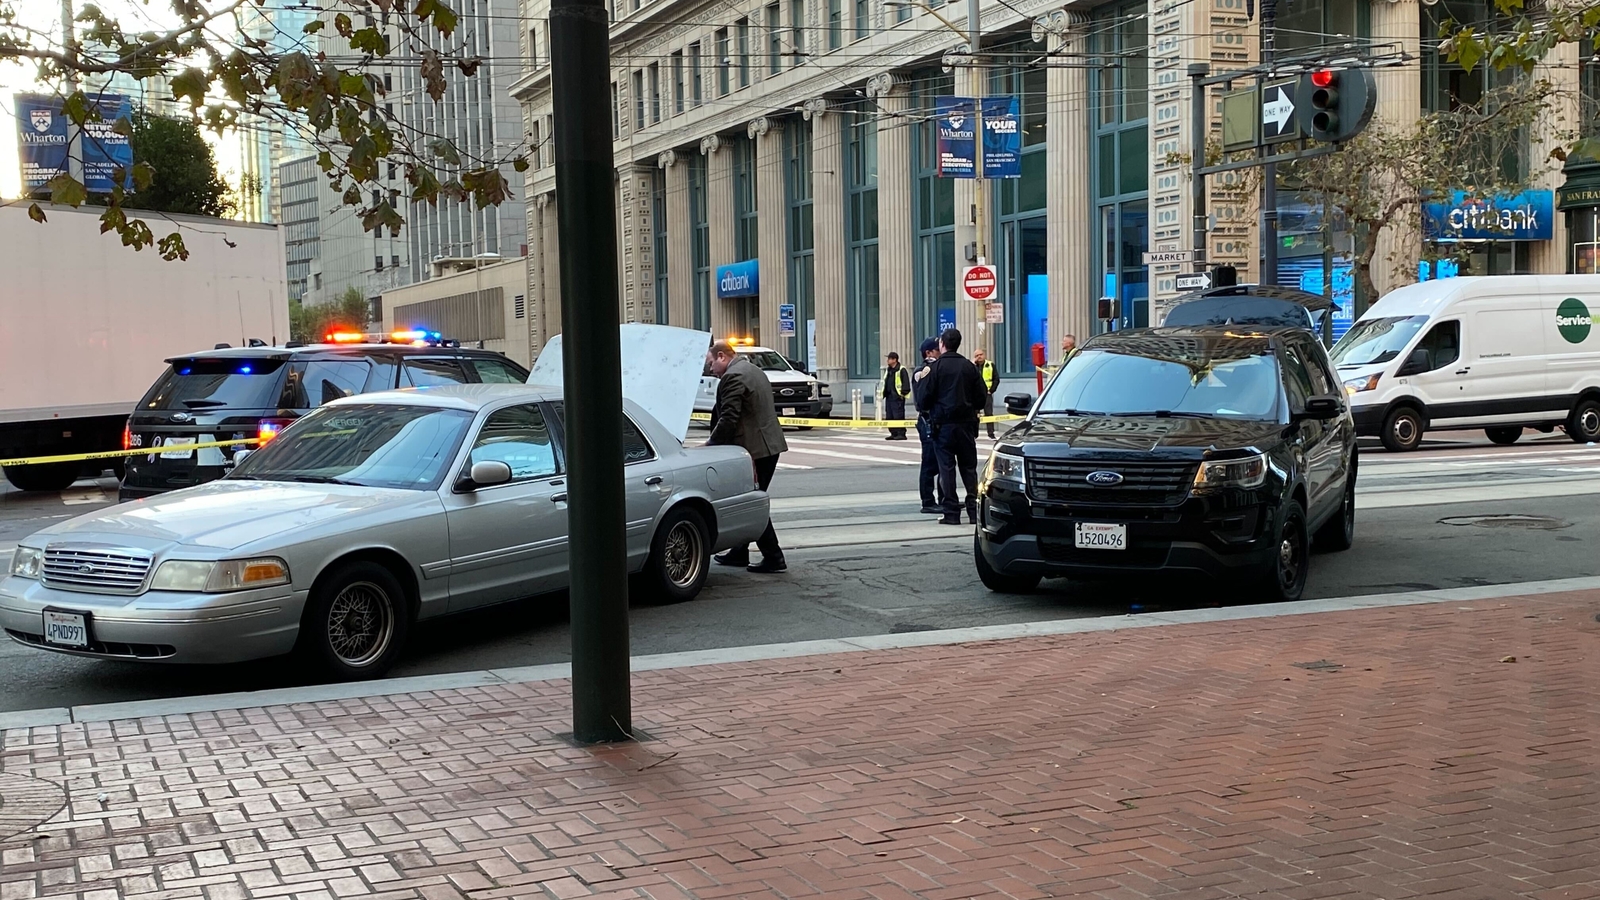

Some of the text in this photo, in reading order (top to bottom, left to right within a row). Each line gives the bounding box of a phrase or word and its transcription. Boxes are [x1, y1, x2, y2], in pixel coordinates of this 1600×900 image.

[1265, 105, 1291, 117] ONE WAY
[985, 120, 1017, 129] YOUR
[20, 132, 66, 143] Wharton
[941, 128, 973, 138] Wharton
[1567, 193, 1580, 201] SAN
[1151, 253, 1186, 261] MARKET
[721, 271, 749, 291] citibank
[1093, 473, 1114, 482] Ford
[1079, 533, 1122, 546] 1520496
[48, 624, 83, 640] 4PND997
